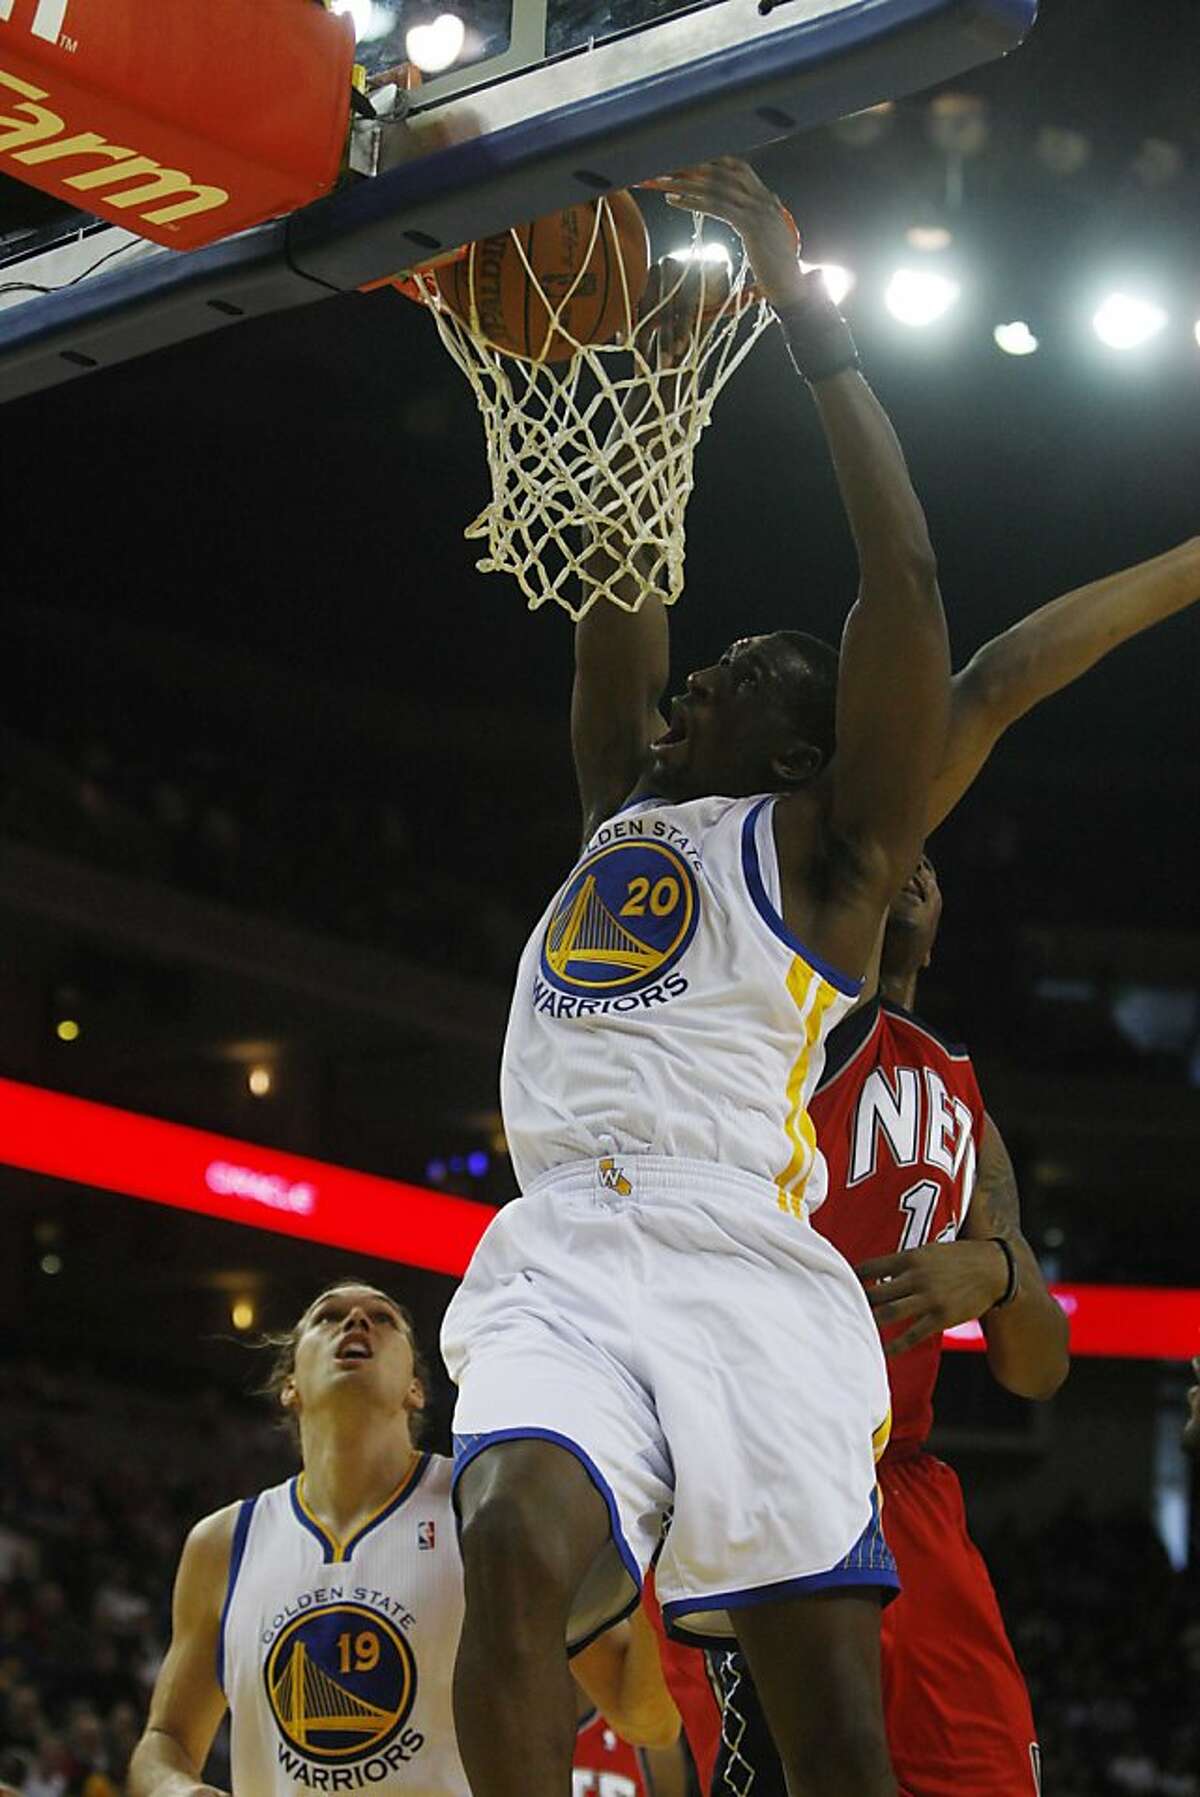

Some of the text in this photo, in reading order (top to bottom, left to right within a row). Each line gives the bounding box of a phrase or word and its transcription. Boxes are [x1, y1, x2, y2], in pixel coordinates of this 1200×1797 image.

[0, 70, 229, 225] arm
[619, 876, 680, 917] 20
[262, 1586, 416, 1644] GOLDEN STATE
[337, 1631, 381, 1674] 19
[277, 1727, 424, 1791] WARRIORS
